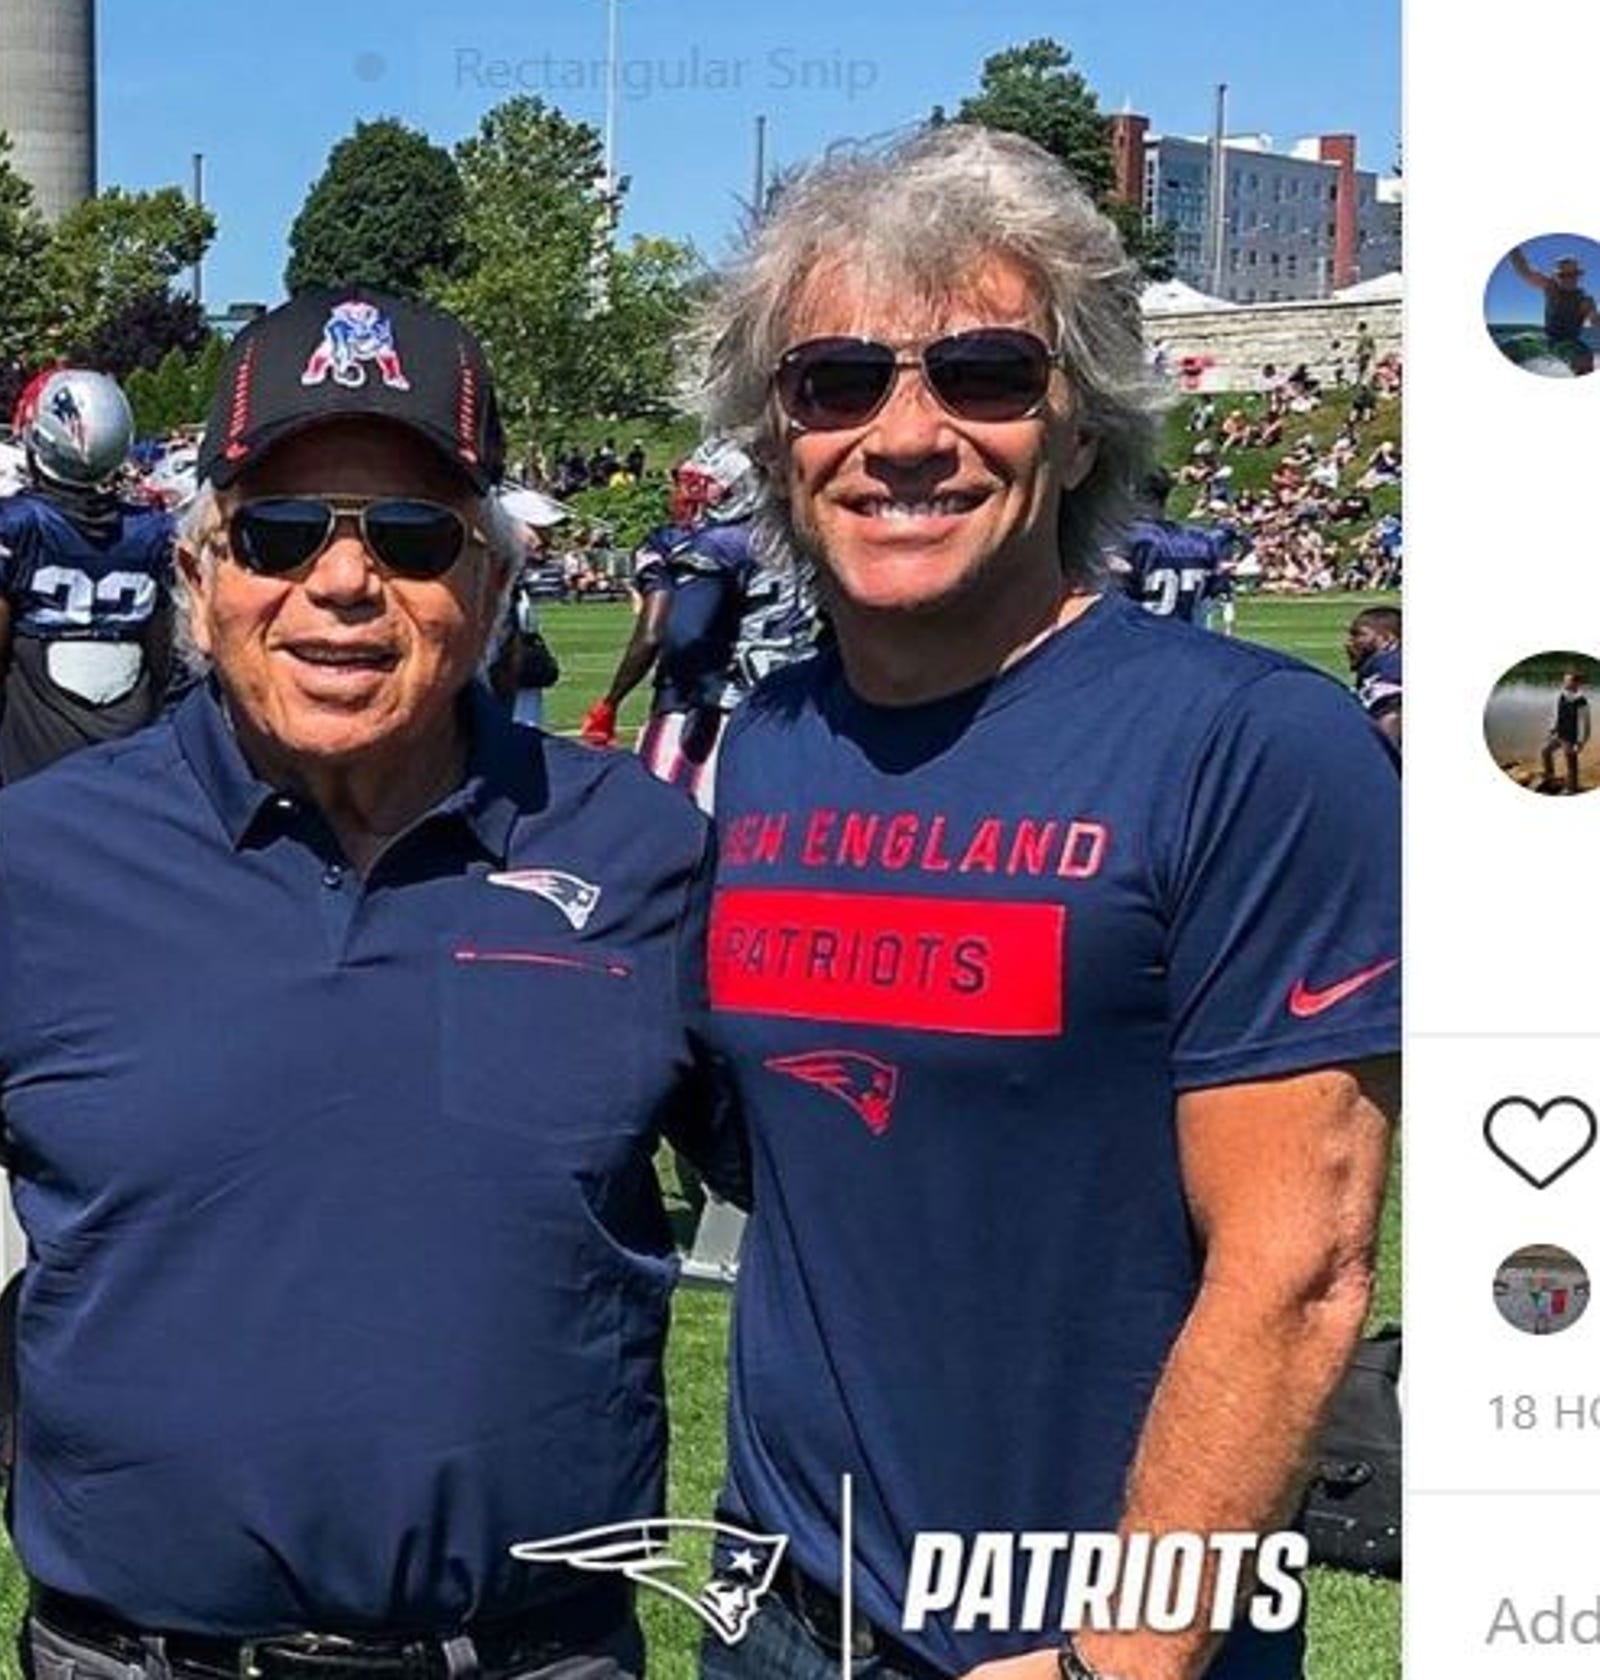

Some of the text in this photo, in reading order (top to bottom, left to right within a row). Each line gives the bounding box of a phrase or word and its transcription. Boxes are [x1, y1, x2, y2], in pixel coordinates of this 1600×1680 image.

[802, 808, 1108, 878] ENGLAND
[722, 926, 991, 995] PATRIOTS
[1489, 1395, 1537, 1430] 18
[1485, 1594, 1600, 1645] Add
